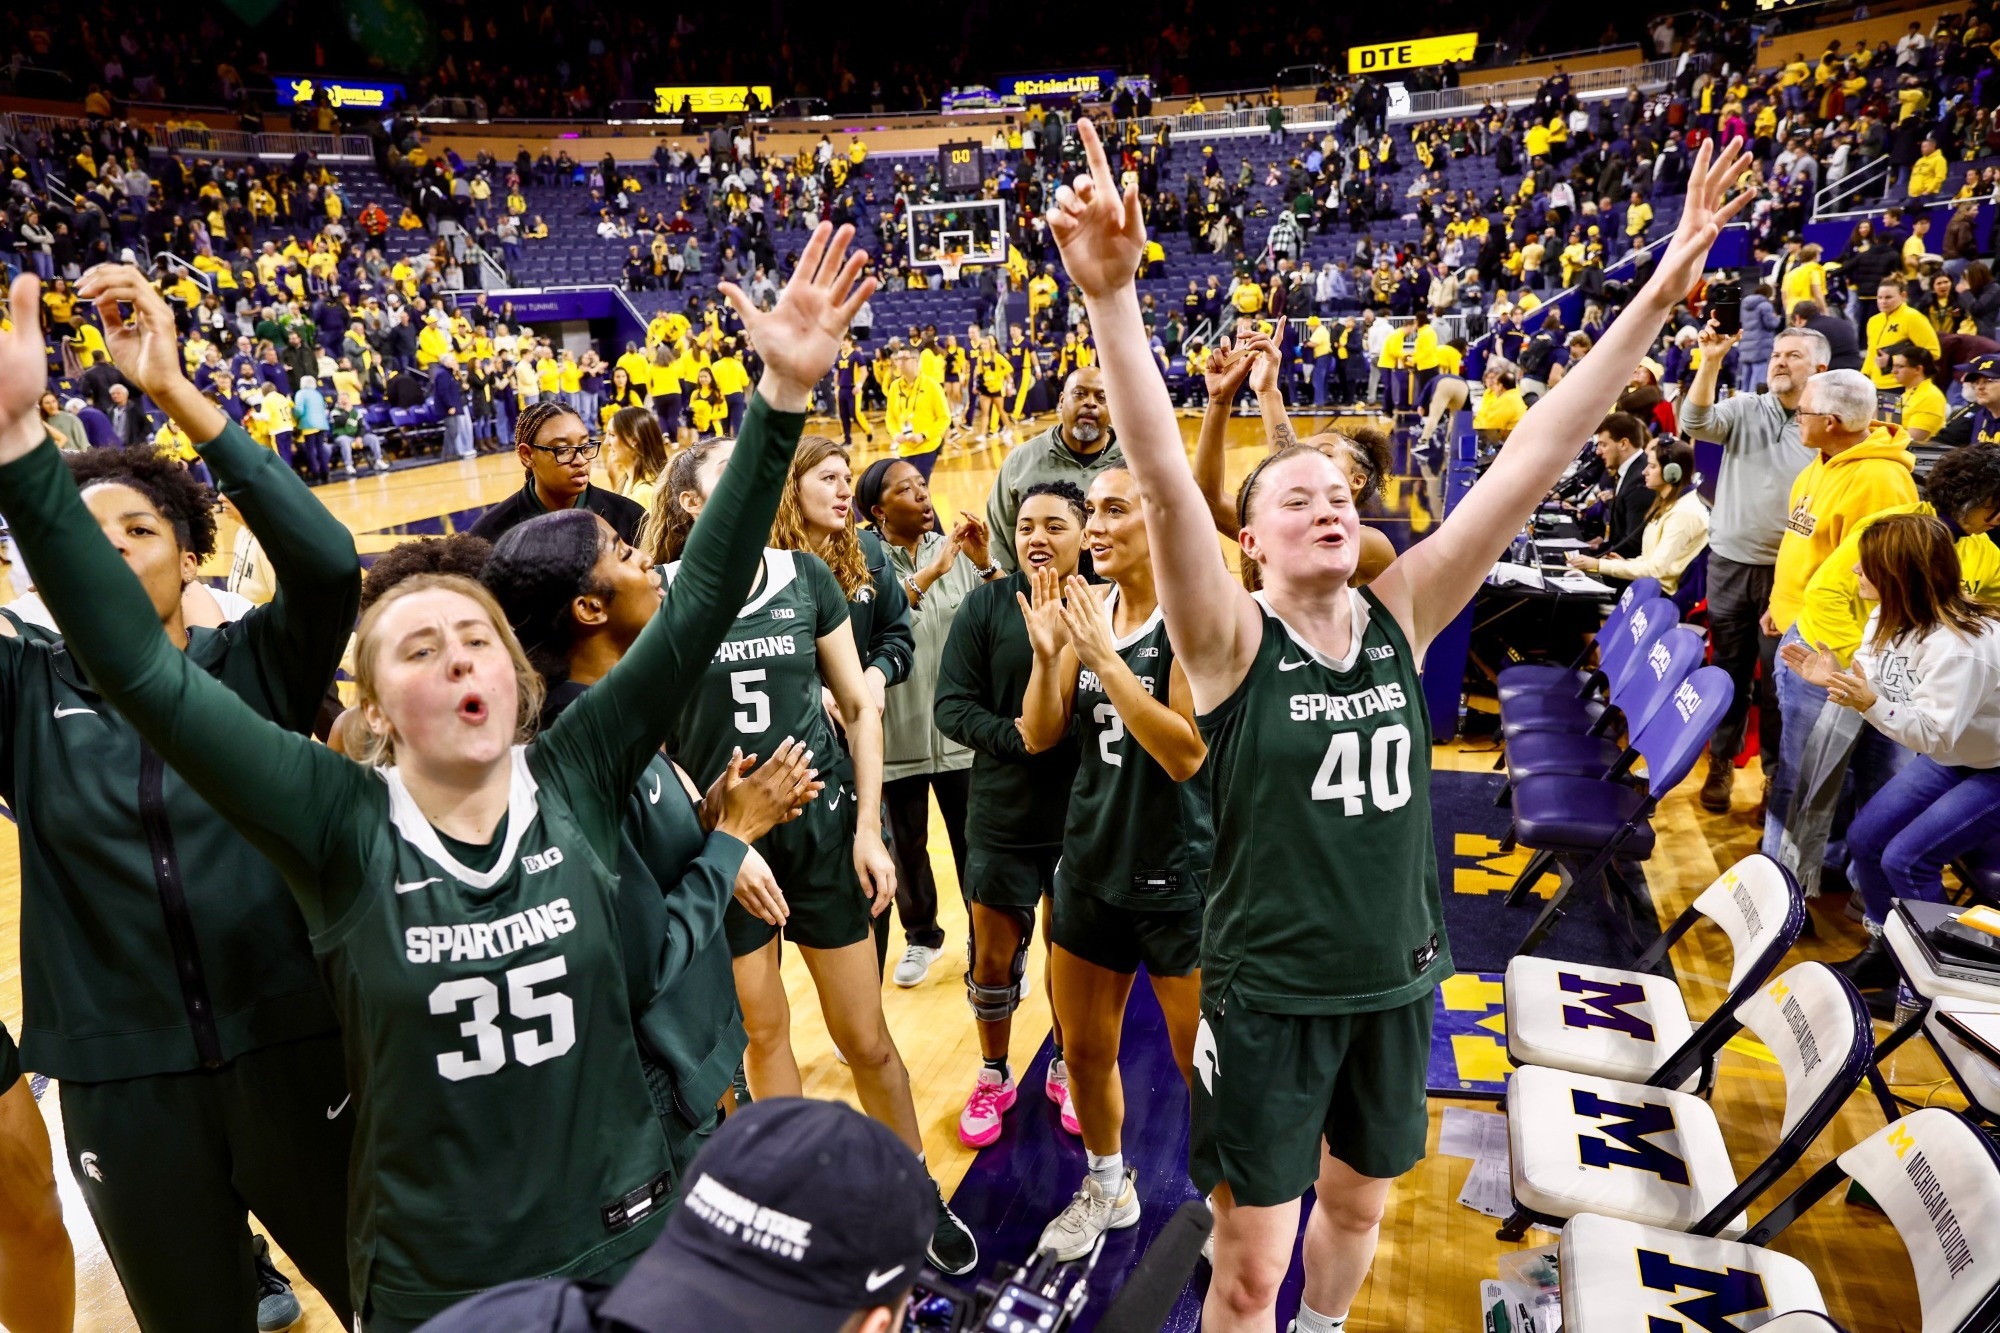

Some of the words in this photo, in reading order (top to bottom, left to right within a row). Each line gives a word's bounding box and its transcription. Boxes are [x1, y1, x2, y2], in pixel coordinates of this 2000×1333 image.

[1014, 76, 1100, 96] #CrislerLIVE
[1361, 45, 1412, 69] DTE
[529, 302, 559, 311] TUNNEL
[711, 634, 796, 664] ARTANS
[730, 668, 771, 734] 5
[1290, 682, 1407, 722] SPARTANS
[1093, 703, 1124, 767] 2
[1311, 723, 1412, 817] 40
[405, 897, 577, 964] SPARTANS
[428, 955, 576, 1082] 35
[1557, 970, 1656, 1043] M
[1781, 994, 1811, 1044] MICHIGAN
[1798, 1031, 1822, 1078] MEDICINE
[1569, 1087, 1693, 1188] M
[1886, 1122, 1916, 1160] M
[1905, 1150, 1949, 1222] MICHIGAN
[1934, 1208, 1975, 1281] MEDICINE
